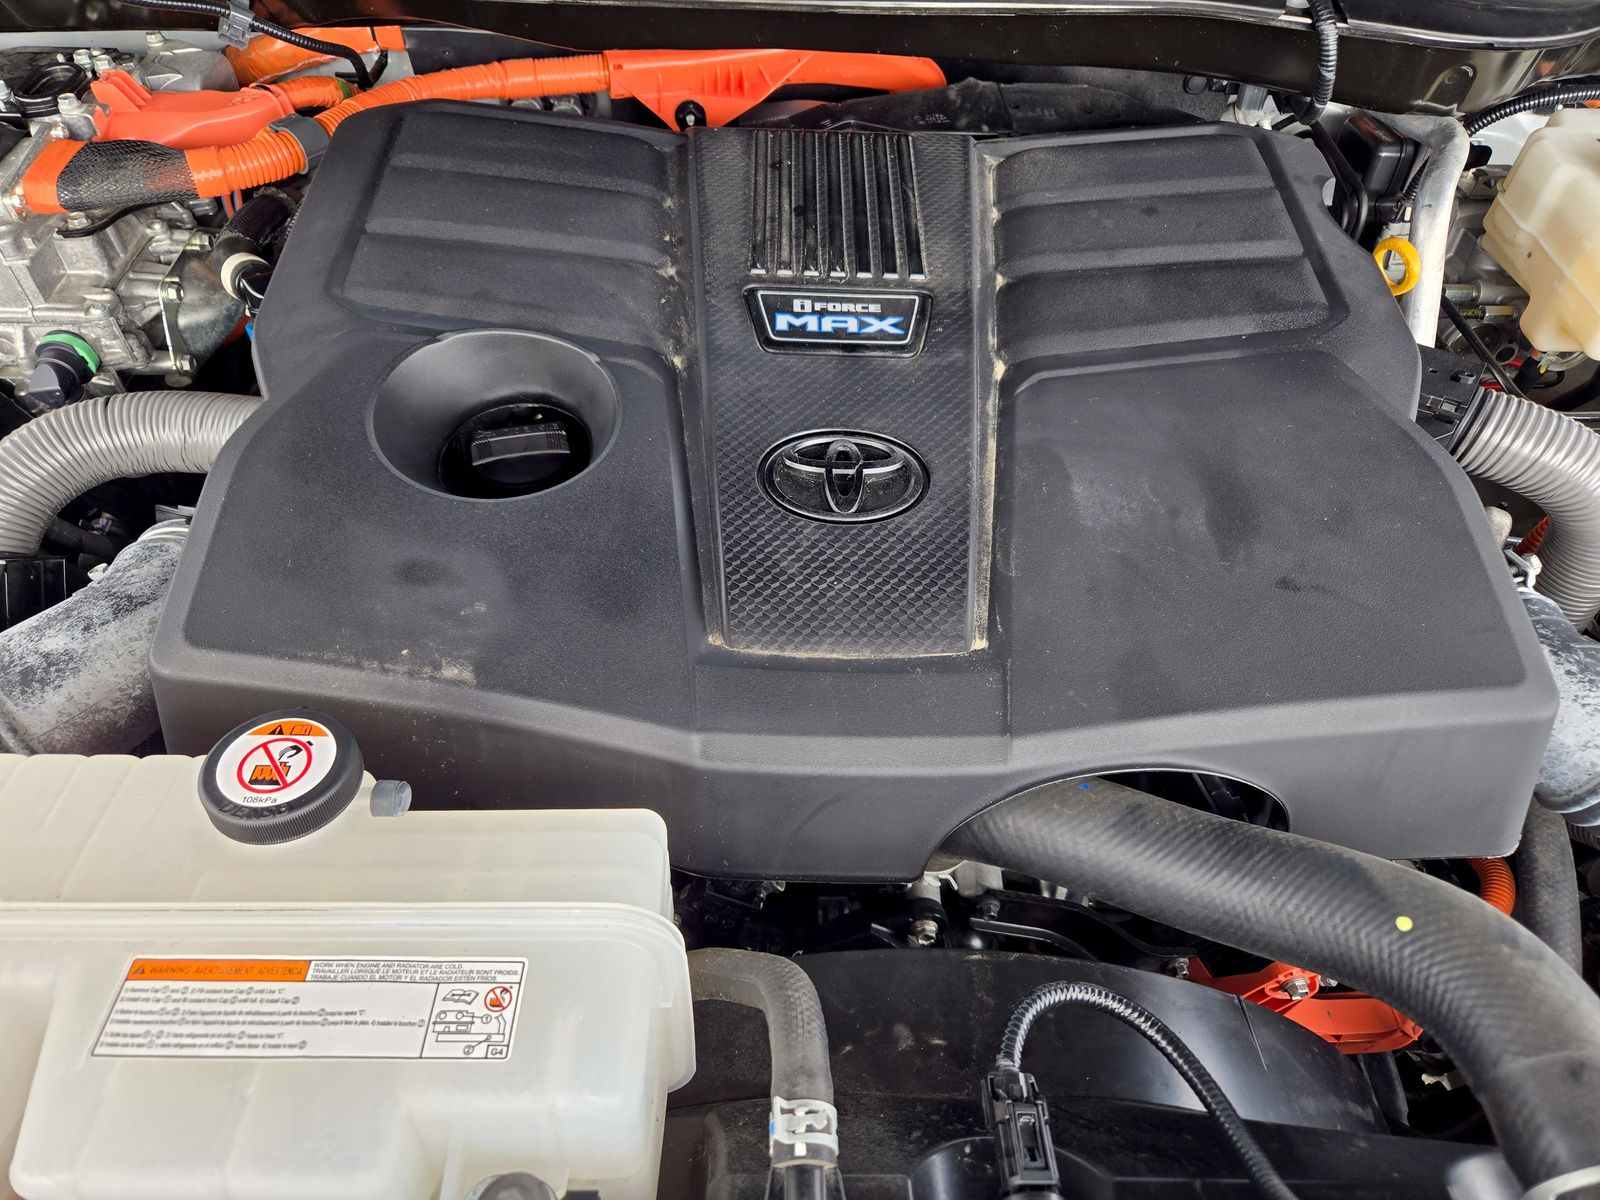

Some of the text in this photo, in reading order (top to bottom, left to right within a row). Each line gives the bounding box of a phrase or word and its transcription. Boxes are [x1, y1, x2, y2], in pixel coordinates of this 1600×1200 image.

[774, 312, 905, 335] MAX
[242, 796, 278, 804] 108kPa
[150, 965, 303, 976] WARNING AVERTISSEMENT ADVERTENCIA
[490, 1047, 504, 1056] G4
